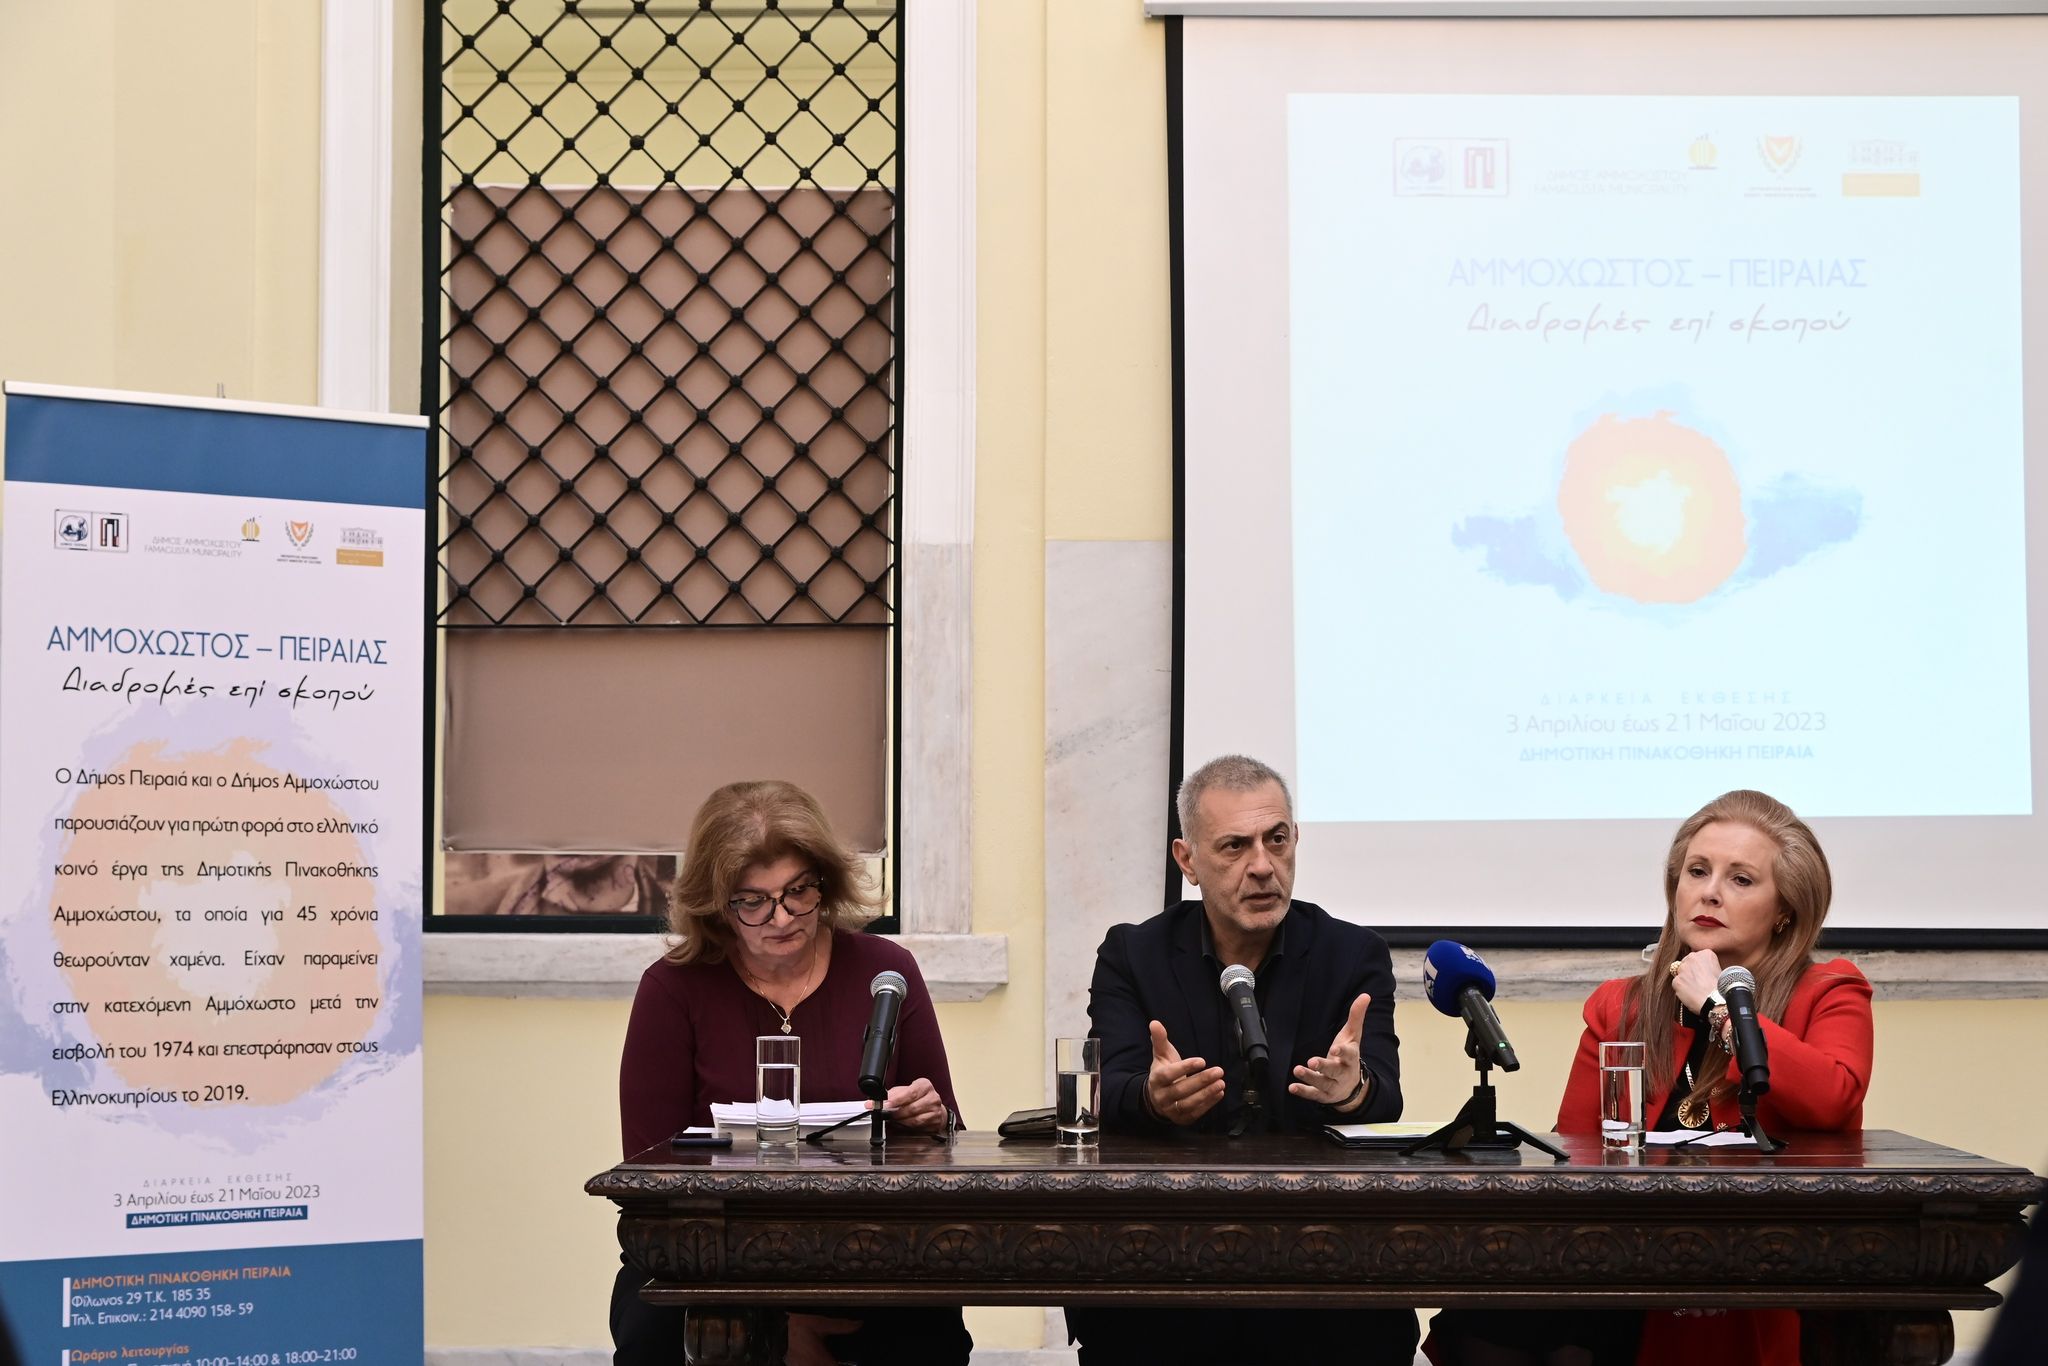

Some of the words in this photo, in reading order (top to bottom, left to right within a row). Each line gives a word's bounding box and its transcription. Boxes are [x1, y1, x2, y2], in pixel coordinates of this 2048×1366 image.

[1447, 258, 1694, 287] ΑΜΜΟΧΩΣΤΟΣ
[1729, 258, 1868, 287] ΠΕΙΡΑΙΑΣ
[1467, 302, 1651, 343] Διαδρομές
[1669, 310, 1716, 341] επί
[1728, 303, 1852, 344] σκοπού
[46, 625, 250, 659] ΑΜΜΟΧΩΣΤΟΣ
[279, 635, 388, 665] ΠΕΙΡΑΙΑΣ
[62, 666, 215, 706] Διαδρομές
[228, 679, 266, 708] επί
[278, 674, 375, 711] σκοπού
[1540, 692, 1651, 704] ΔΙΑΡΚΕΙΑ
[1681, 691, 1792, 704] ΕΚΘΕΣΗΣ
[1506, 714, 1519, 733] 3
[1526, 713, 1615, 738] Απριλίου
[1622, 713, 1659, 732] έως
[1666, 713, 1691, 731] 21
[1700, 712, 1765, 731] Μαΐου
[1773, 712, 1826, 731] 2023
[1520, 746, 1613, 761] ΔΗΜΟΤΙΚΗ
[1619, 746, 1741, 760] ΠΙΝΑΚΟΘΗΚΗ
[1748, 745, 1814, 759] ΠΕΙΡΑΙΑ
[55, 767, 72, 785] Ο
[75, 768, 126, 789] Δήμος
[129, 769, 188, 791] Πειραιά
[191, 775, 212, 787] και
[216, 775, 228, 788] ο
[230, 772, 280, 792] Δήμος
[283, 772, 379, 794] Αμμοχώστου
[54, 815, 166, 835] παρουσιάζουν
[167, 819, 190, 836] για
[192, 816, 239, 837] πρώτη
[241, 816, 284, 838] φορά
[286, 821, 315, 833] στο
[316, 818, 379, 834] ελληνικό
[54, 860, 99, 876] κοινό
[111, 860, 148, 881] έργα
[160, 864, 185, 877] της
[196, 860, 272, 881] Δημοτικής
[285, 861, 379, 878] Πινακοθήκης
[53, 905, 162, 927] Αμμοχώστου,
[174, 910, 191, 922] τα
[204, 905, 248, 922] οποία
[260, 910, 284, 926] για
[296, 905, 317, 922] 45
[330, 906, 379, 926] χρόνια
[53, 951, 151, 973] θεωρούνταν
[169, 950, 225, 972] χαμένα.
[244, 949, 286, 966] Είχαν
[303, 949, 378, 970] παραμείνει
[52, 1001, 90, 1015] στην
[104, 996, 192, 1017] κατεχόμενη
[205, 995, 296, 1016] Αμμόχωστο
[310, 994, 342, 1015] μετά
[354, 997, 379, 1009] την
[51, 1042, 115, 1063] εισβολή
[118, 1046, 147, 1059] του
[153, 1040, 194, 1058] 1974
[197, 1044, 219, 1057] και
[222, 1039, 333, 1060] επεστράφησαν
[336, 1041, 379, 1054] στους
[51, 1087, 178, 1109] Ελληνοκυπρίους
[181, 1090, 200, 1103] το
[203, 1084, 249, 1102] 2019.
[142, 1176, 211, 1188] ΔΙΑΡΚΕΙΑ
[227, 1172, 292, 1184] ΕΚΘΕΣΗΣ
[113, 1193, 123, 1208] 3
[126, 1191, 187, 1210] Απριλίου
[189, 1190, 215, 1204] έως
[218, 1188, 234, 1203] 21
[239, 1186, 282, 1201] Μαΐου
[284, 1184, 321, 1200] 2023
[131, 1212, 188, 1226] ΔΗΜΟΤΙΚΗ
[190, 1209, 262, 1224] ΠΙΝΑΚΟΘΗΚΗ
[263, 1207, 304, 1220] ΠΕΙΡΑΙΑ
[71, 1274, 145, 1290] ΔΗΜΟΤΙΚΗ
[148, 1268, 239, 1285] ΠΙΝΑΚΟΘΗΚΗ
[242, 1265, 292, 1280] ΠΕΙΡΑΙΑ
[71, 1294, 124, 1308] Φίλωνος
[125, 1291, 143, 1305] 29
[143, 1290, 167, 1304] Τ.Κ.
[171, 1288, 193, 1302] 185
[195, 1287, 212, 1301] 35
[71, 1313, 95, 1326] Τηλ.
[97, 1311, 147, 1325] Επικοιν.:
[149, 1307, 174, 1322] 214
[175, 1305, 208, 1320] 4090
[210, 1303, 236, 1317] 158-
[238, 1302, 254, 1316] 59
[70, 1348, 118, 1365] Ωράριο
[121, 1344, 190, 1362] λειτουργίας
[270, 1353, 281, 1366] &
[284, 1347, 357, 1364] 18:00–21:00
